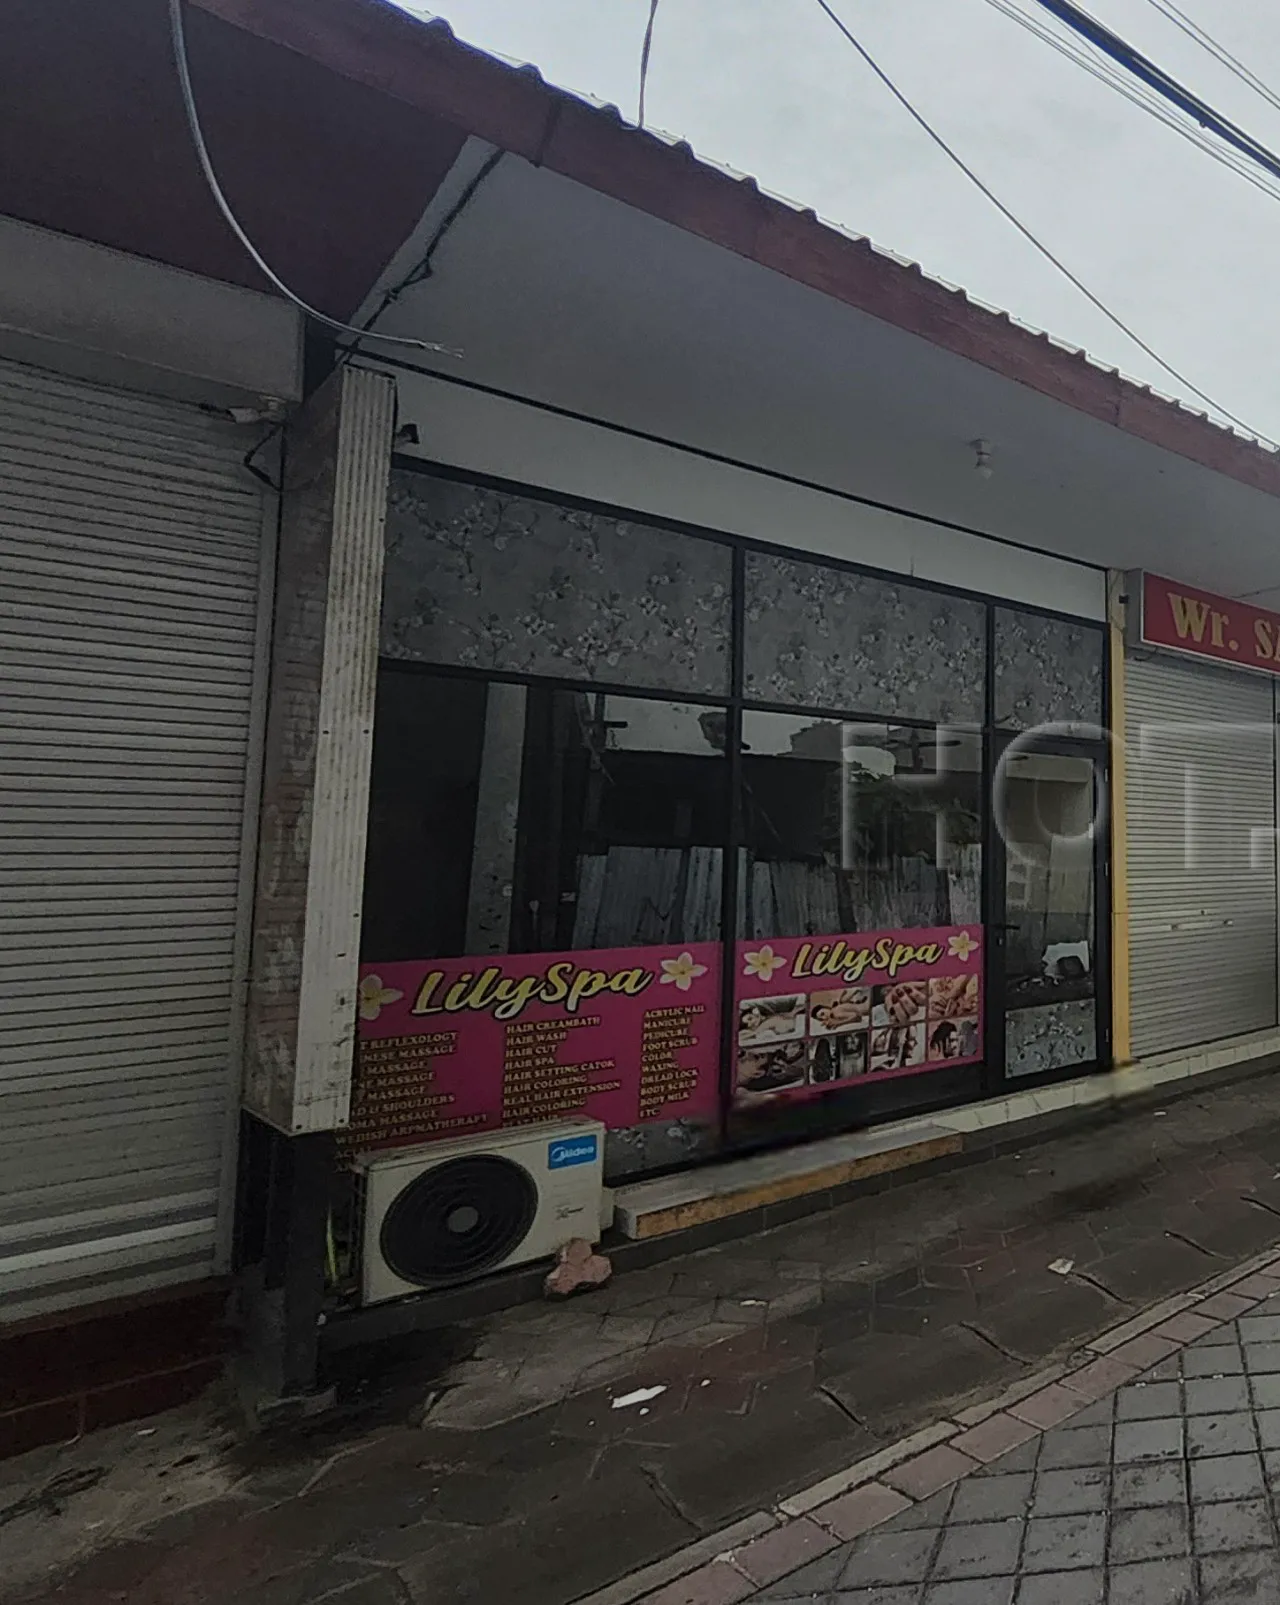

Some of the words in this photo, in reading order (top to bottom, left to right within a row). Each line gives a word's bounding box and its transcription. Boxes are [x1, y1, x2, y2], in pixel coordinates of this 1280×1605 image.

[1167, 591, 1239, 651] Wr.
[507, 1023, 534, 1034] HAIR
[536, 1016, 601, 1031] CREAMBATH
[370, 1032, 457, 1050] REFLEXOLOGY
[506, 1035, 534, 1046] HAIR
[536, 1031, 567, 1043] WASH
[642, 1041, 667, 1052] FOOT
[399, 1045, 456, 1058] MASSAGE
[505, 1047, 533, 1058] HAIR
[535, 1044, 557, 1055] CUT
[641, 1051, 672, 1062] COLOR
[367, 1061, 426, 1075] MASSAGE
[504, 1059, 532, 1070] HAIR
[534, 1056, 555, 1067] SPA
[377, 1071, 435, 1087] MASSAGE
[503, 1071, 532, 1082] HAIR
[534, 1066, 579, 1078] SETTING
[675, 1069, 699, 1080] LOCK
[503, 1082, 531, 1094] HAIR
[533, 1075, 588, 1090] COLORING
[367, 1086, 426, 1100] MASSAGE
[503, 1095, 532, 1106] REAL
[534, 1089, 560, 1101] HAIR
[562, 1081, 621, 1097] EXTENSION
[383, 1094, 456, 1112] SHOULDERS
[503, 1106, 531, 1119] HAIR
[532, 1098, 586, 1113] COLORING
[380, 1109, 436, 1126] MASSAGE
